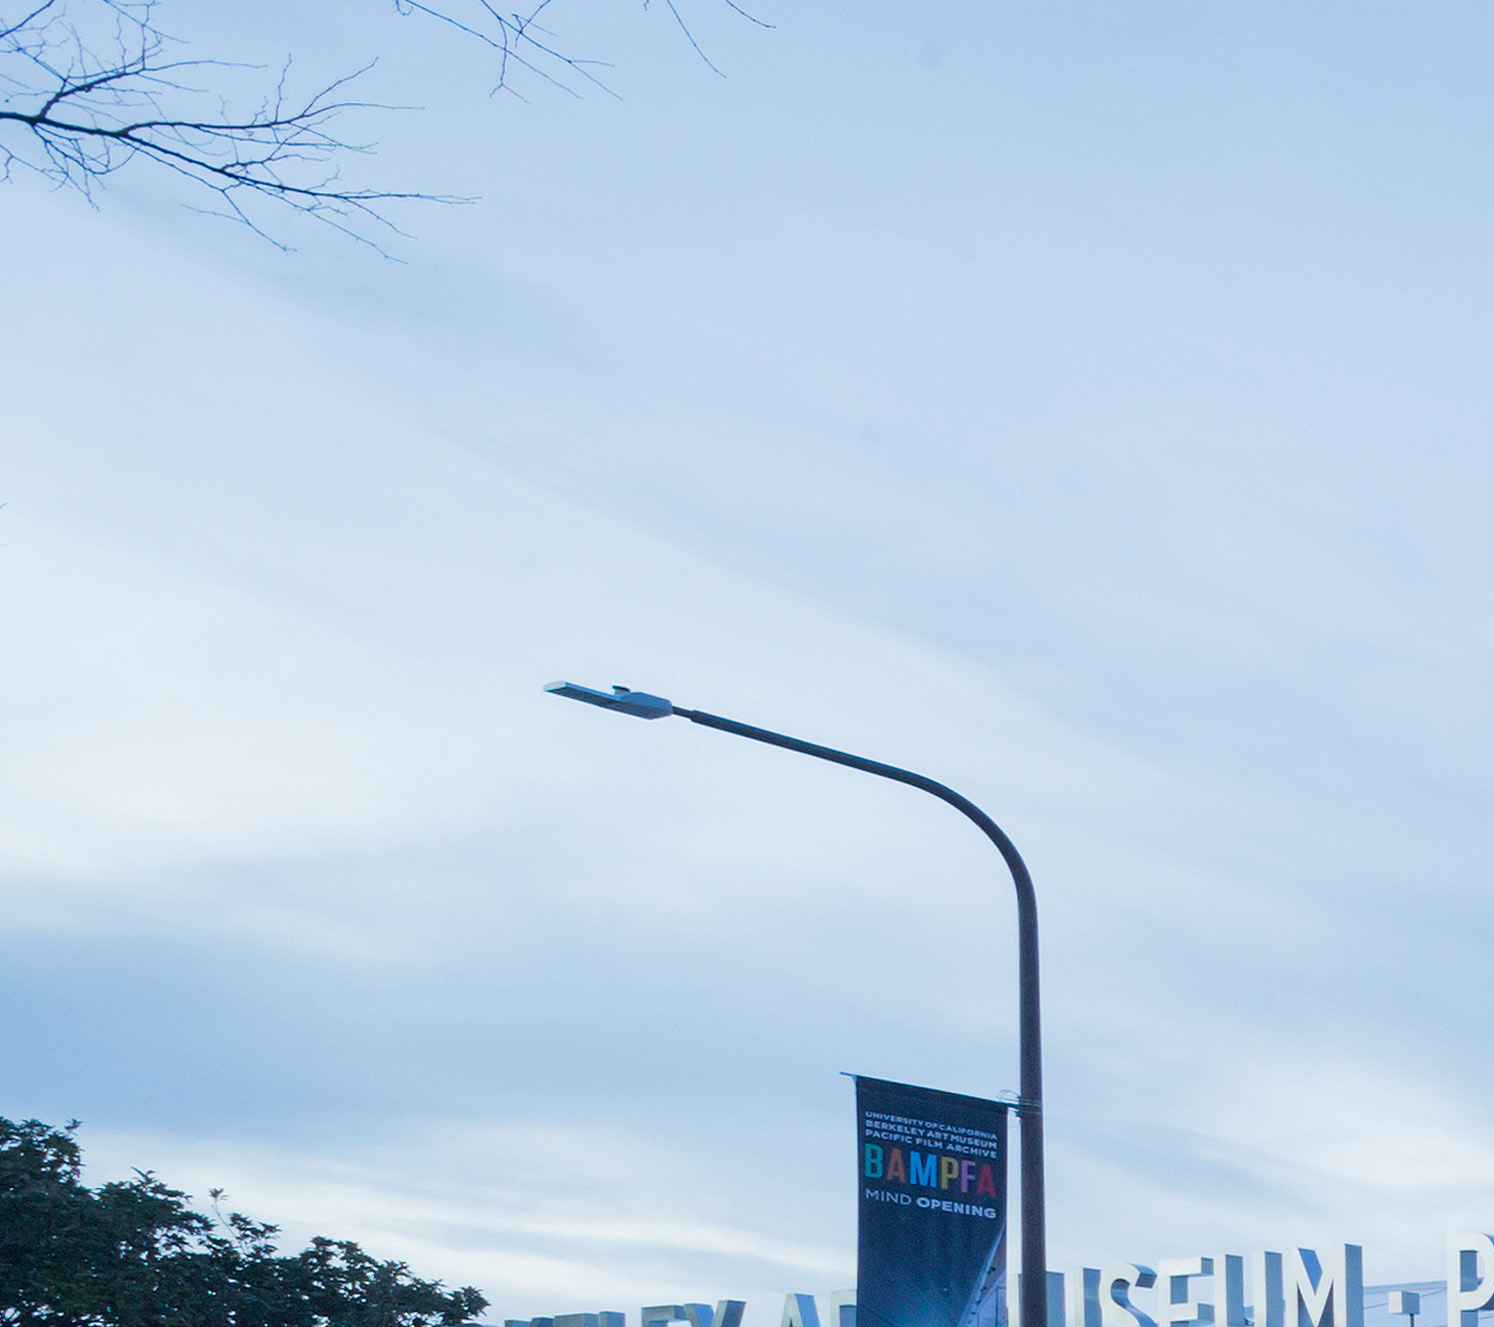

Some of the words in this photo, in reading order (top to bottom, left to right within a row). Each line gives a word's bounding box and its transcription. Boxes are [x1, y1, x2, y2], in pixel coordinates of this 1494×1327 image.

[865, 1111, 923, 1126] UNIVERSITY
[925, 1121, 938, 1129] OF
[938, 1124, 997, 1140] CALIFORNIA
[865, 1119, 925, 1136] BERKELEY
[926, 1130, 949, 1140] ART
[950, 1134, 997, 1149] MUSEUM
[865, 1129, 912, 1144] PACIFIC
[915, 1137, 943, 1149] FILM
[946, 1143, 997, 1159] ARCHIVE
[864, 1143, 996, 1197] BAMPFA
[865, 1188, 912, 1205] MIND
[916, 1197, 997, 1219] OPENING
